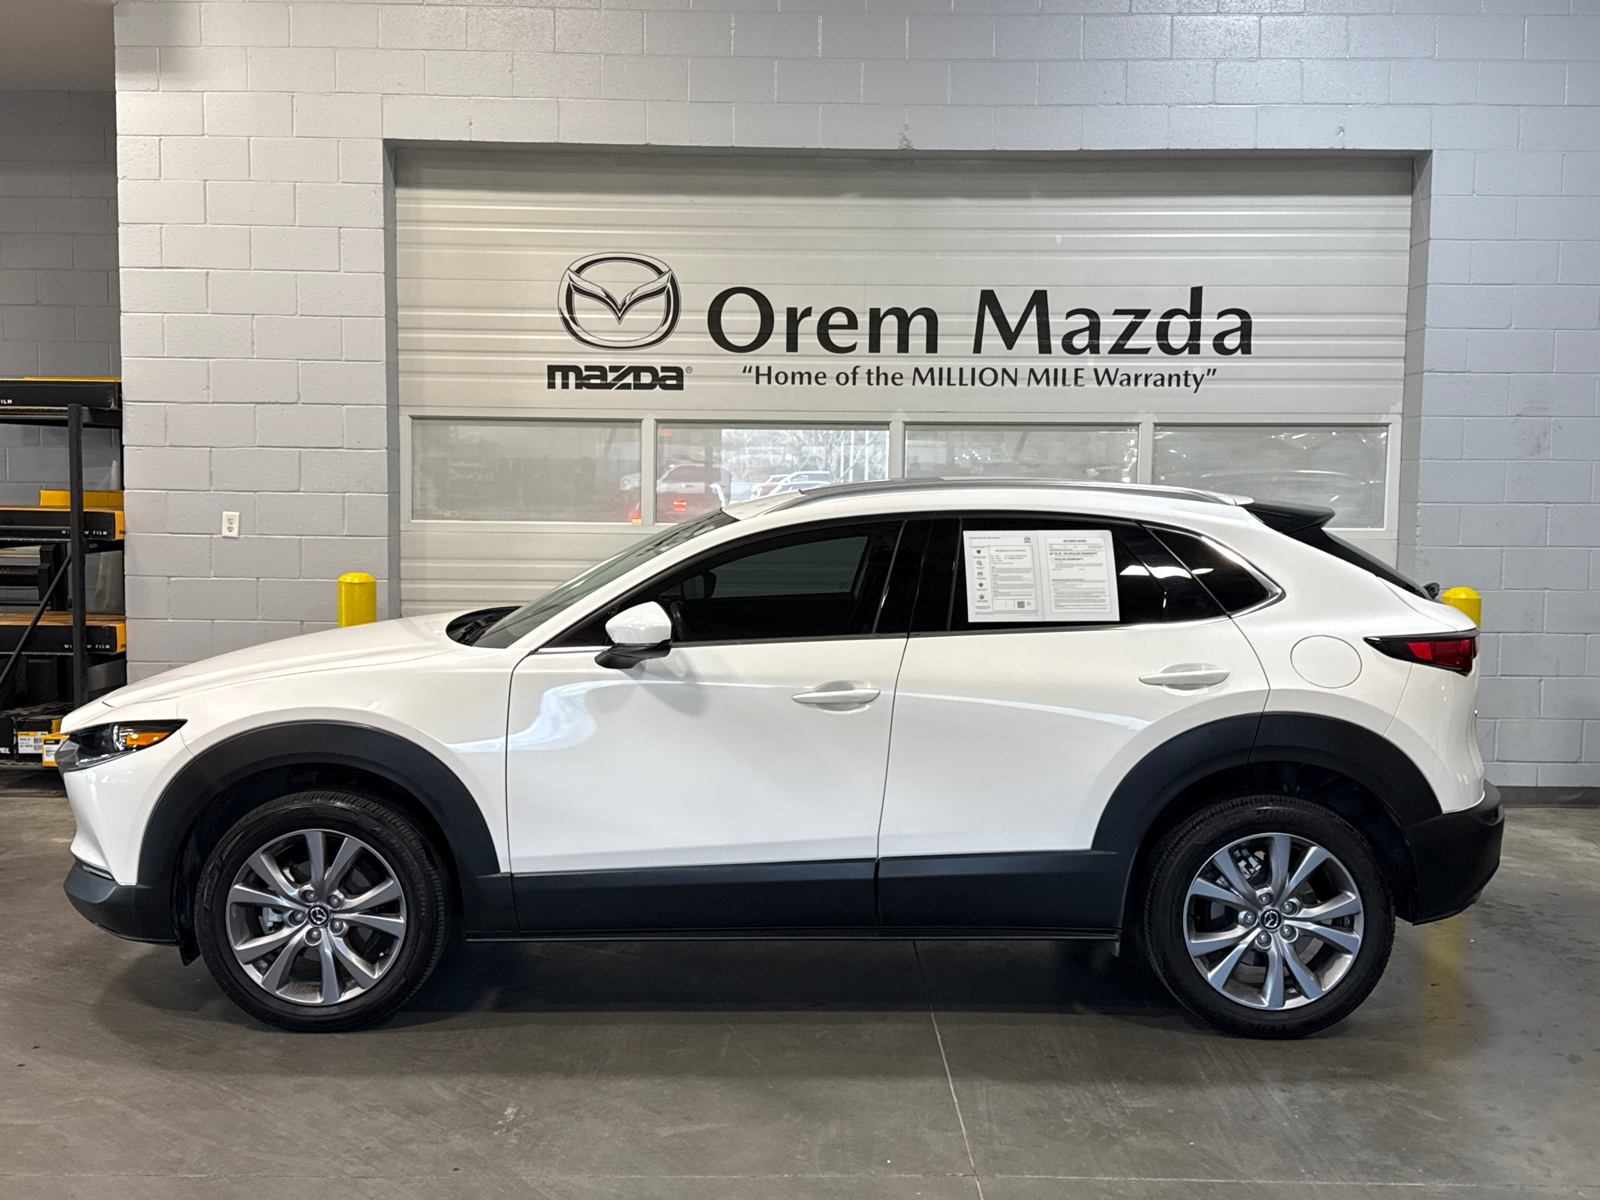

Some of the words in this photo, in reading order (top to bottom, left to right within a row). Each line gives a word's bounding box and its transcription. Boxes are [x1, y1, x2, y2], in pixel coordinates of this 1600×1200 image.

[707, 286, 939, 354] Orem
[972, 285, 1253, 356] Mazda
[835, 365, 861, 386] of
[865, 365, 904, 387] the
[912, 366, 1018, 387] MILLION
[1027, 367, 1085, 387] MILE
